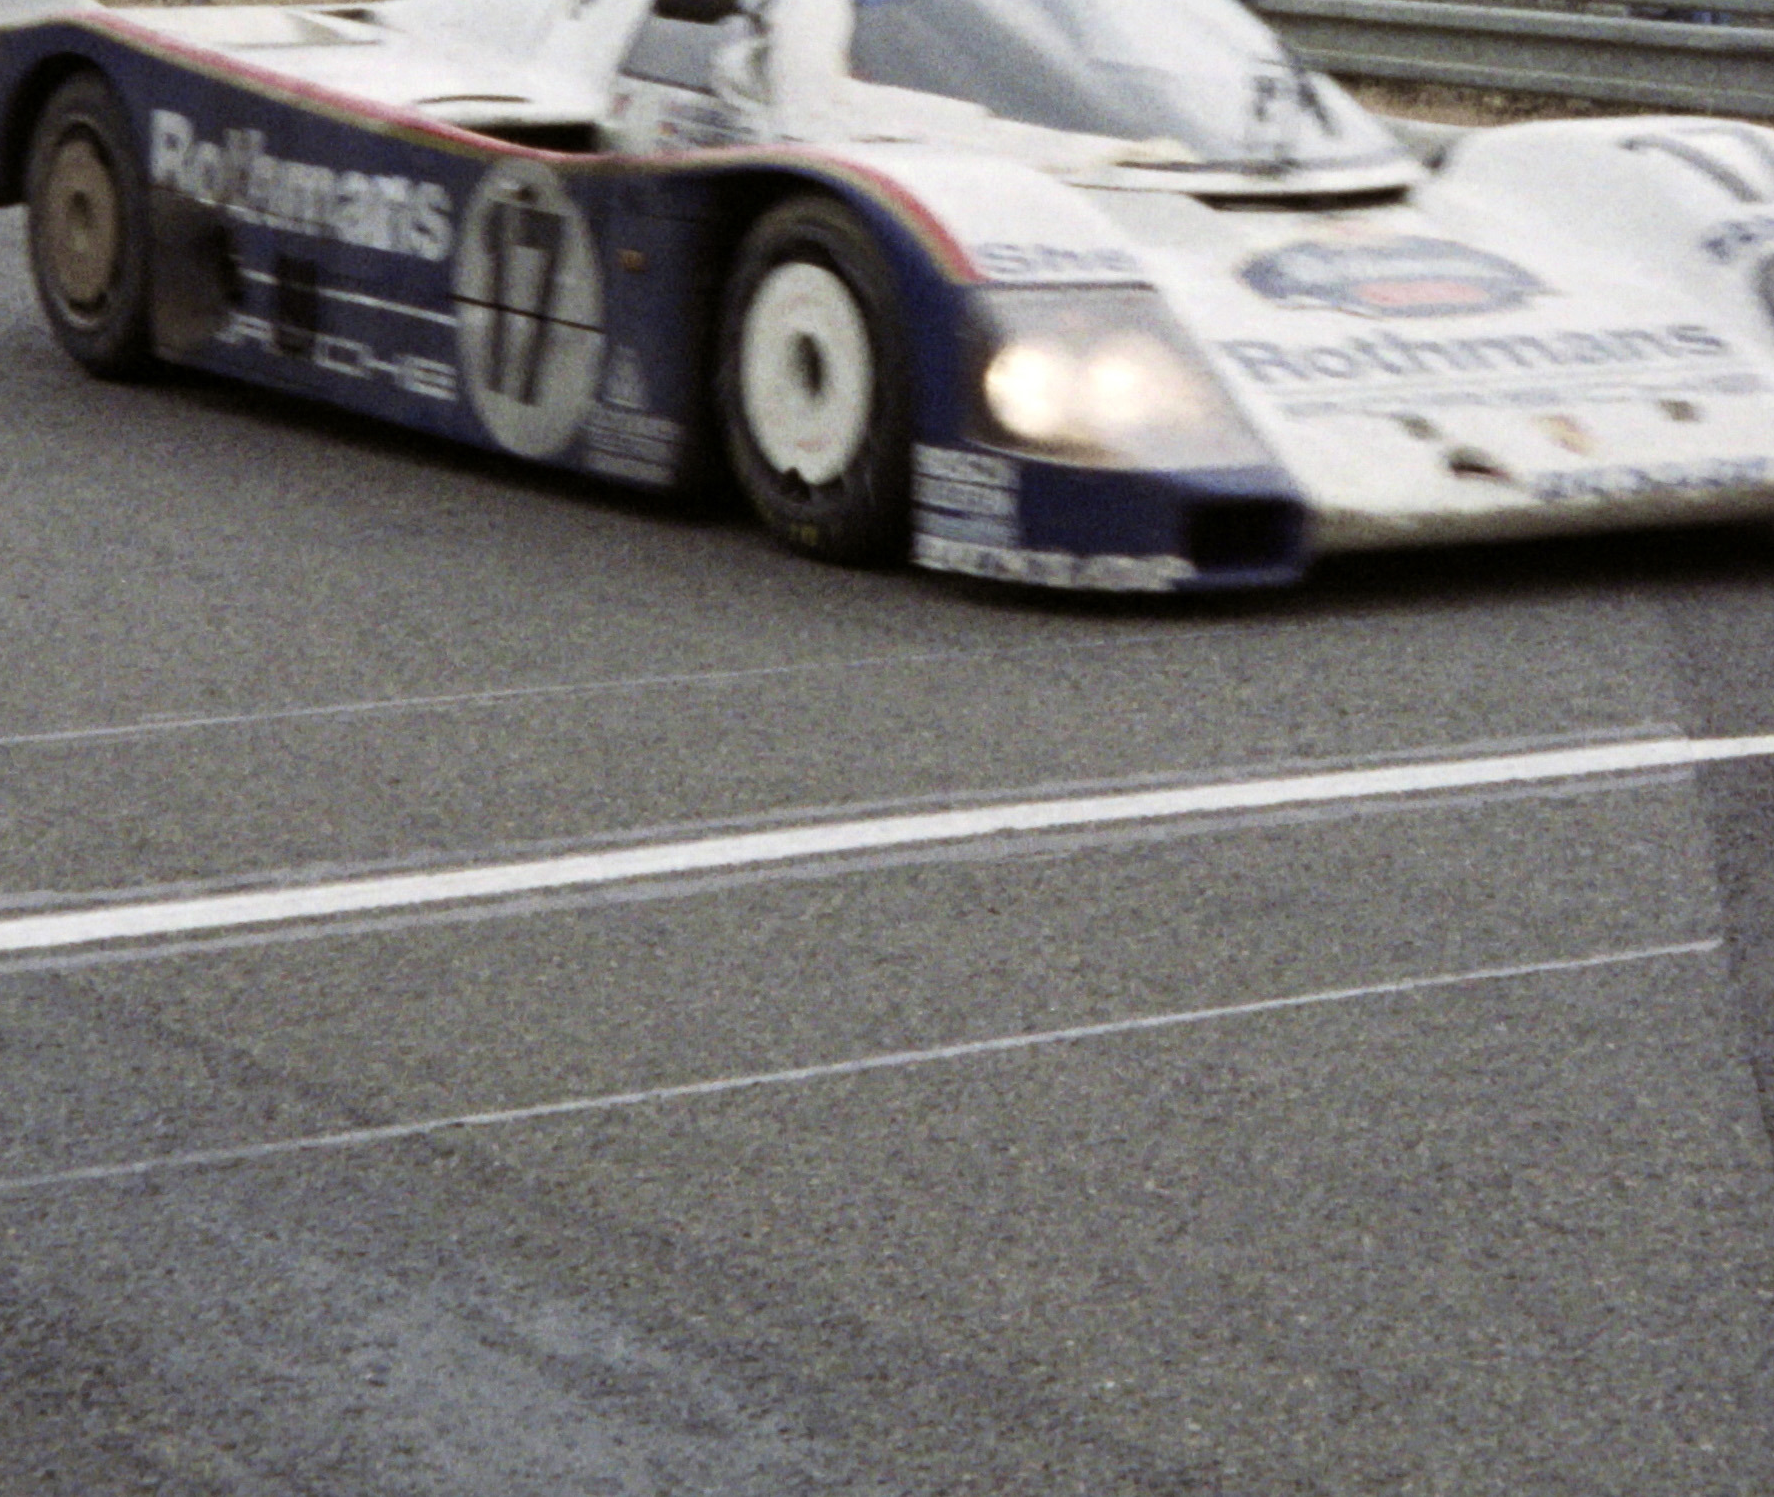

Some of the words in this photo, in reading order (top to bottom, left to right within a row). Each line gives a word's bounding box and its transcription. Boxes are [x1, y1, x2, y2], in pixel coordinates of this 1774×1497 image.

[149, 108, 454, 263] Rothmans
[484, 200, 566, 407] 17
[1216, 319, 1728, 385] Rothmans
